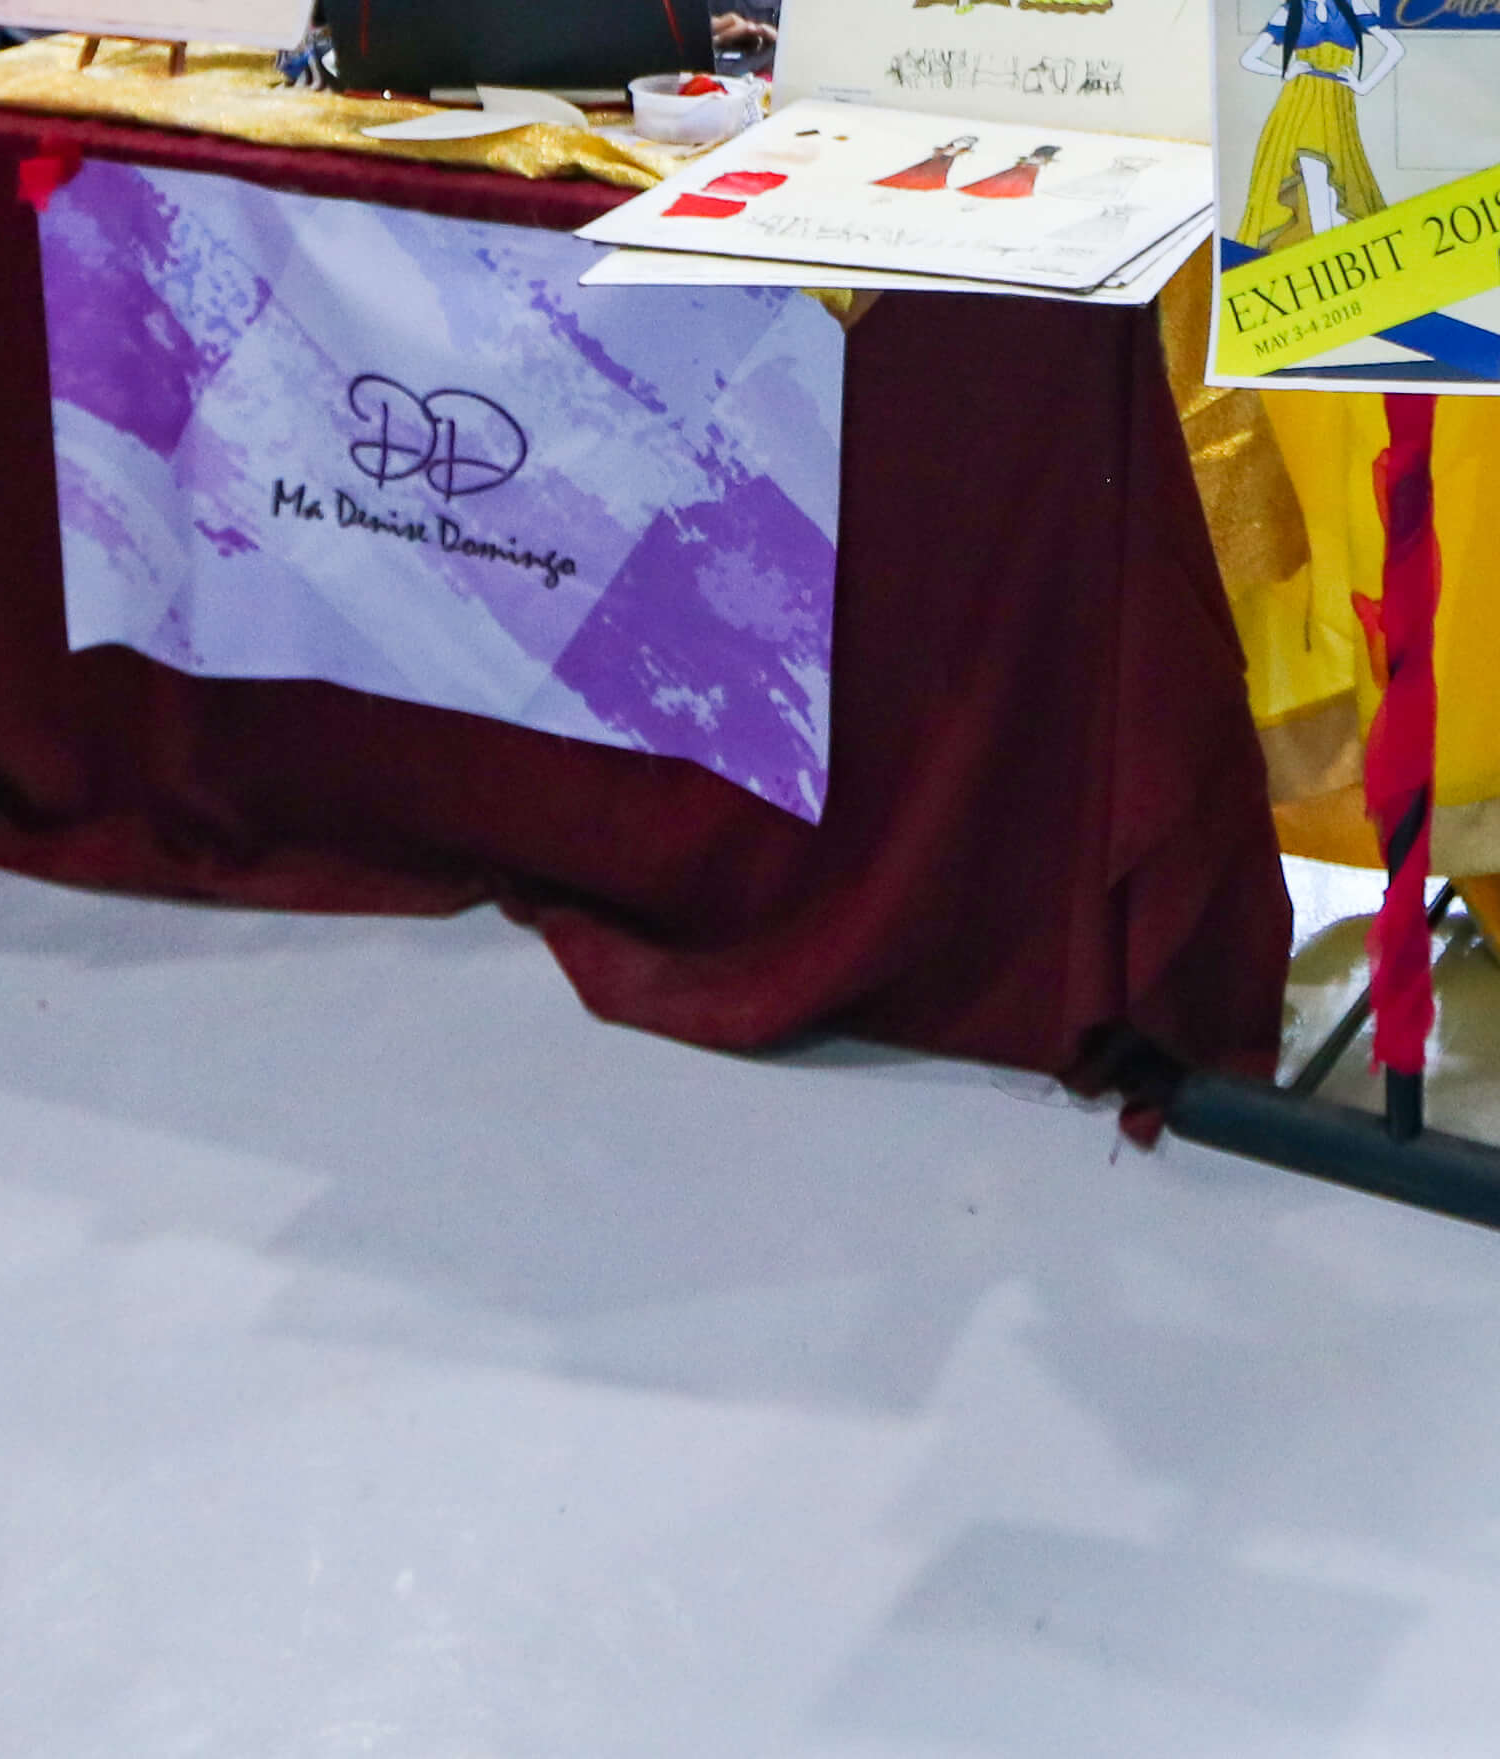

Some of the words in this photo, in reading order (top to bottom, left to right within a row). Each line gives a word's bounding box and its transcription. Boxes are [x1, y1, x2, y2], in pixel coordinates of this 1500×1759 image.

[1226, 229, 1405, 334] EXHIBIT
[1253, 331, 1289, 358] MAY
[1293, 318, 1318, 341] 3-4
[1321, 301, 1363, 330] 2018
[272, 478, 323, 520] Ma
[334, 489, 430, 544] Denise
[437, 516, 578, 590] Domingo
